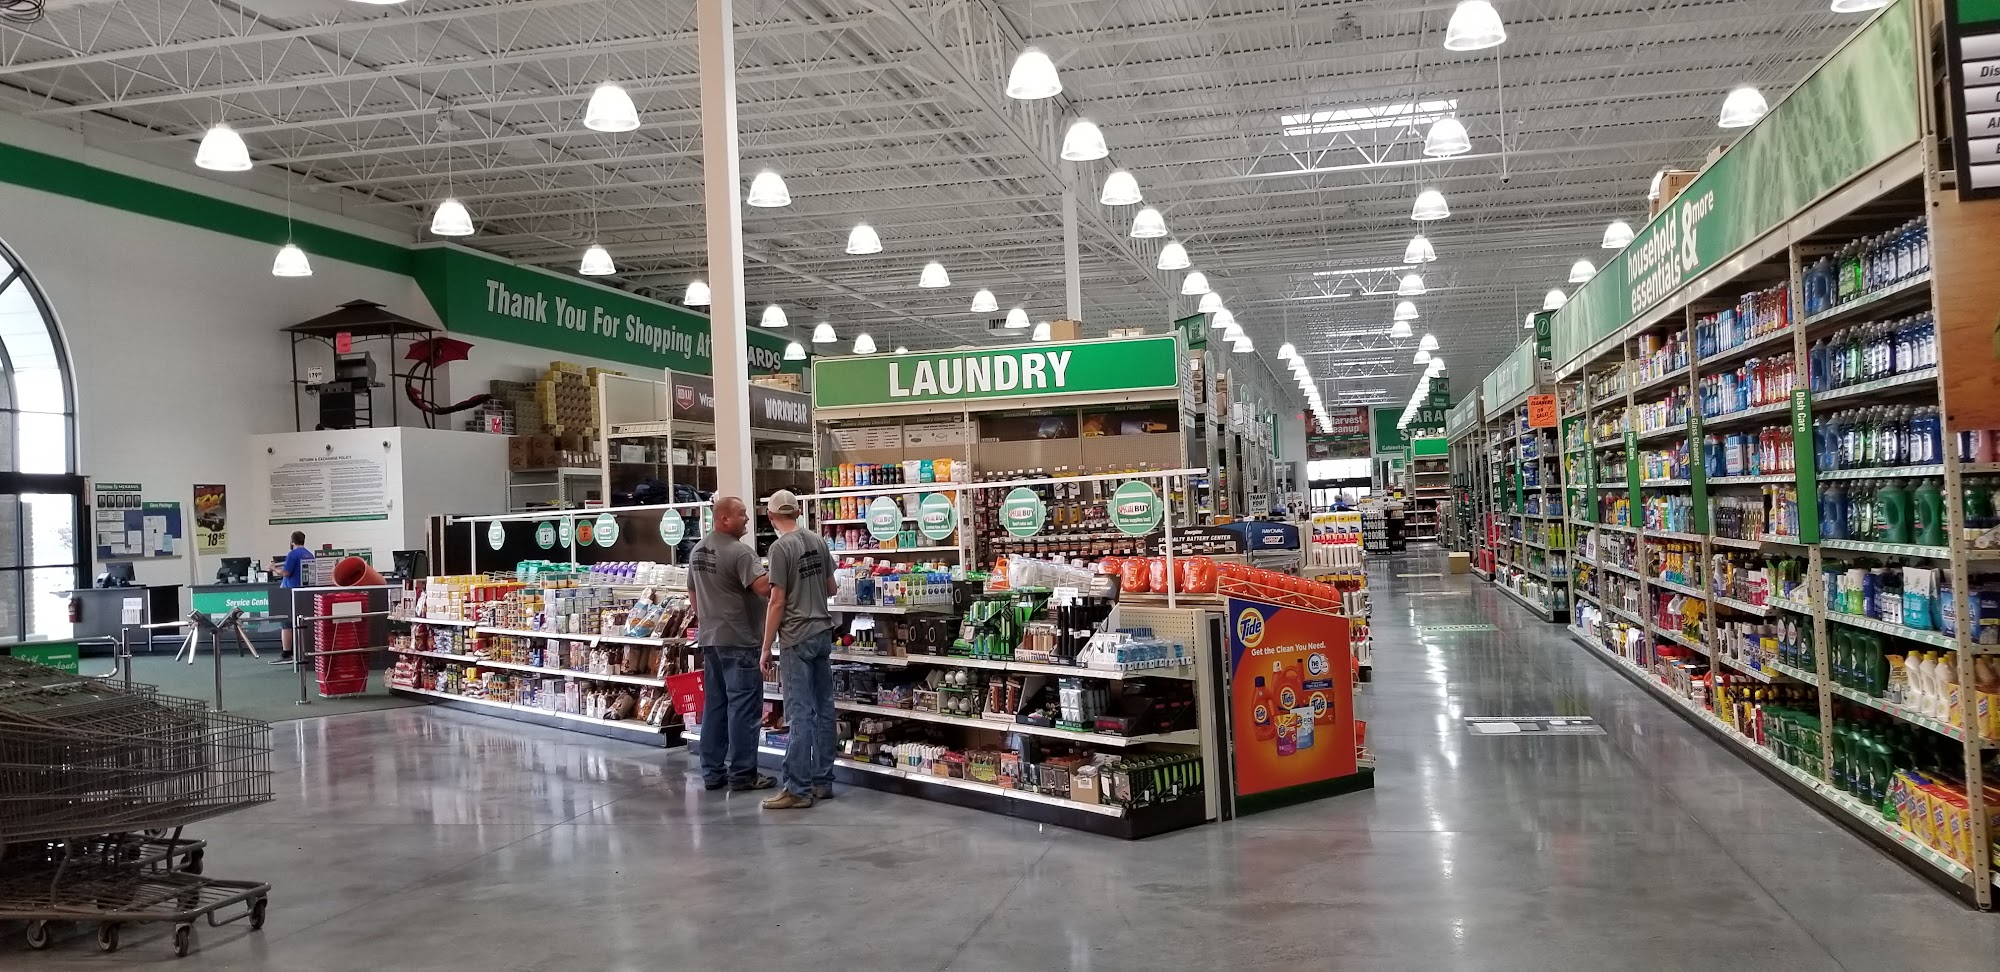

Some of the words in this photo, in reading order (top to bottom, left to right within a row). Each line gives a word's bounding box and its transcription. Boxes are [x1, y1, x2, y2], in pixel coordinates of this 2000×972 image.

[1692, 190, 1714, 225] more
[1628, 207, 1677, 286] household
[1682, 202, 1699, 271] &
[1631, 250, 1681, 315] essentials
[486, 278, 548, 324] Thank
[555, 296, 587, 335] You
[593, 306, 621, 339] For
[625, 314, 693, 360] Shopping
[696, 332, 712, 359] At
[747, 344, 782, 371] ARDS
[889, 350, 1072, 397] LAUNDRY
[699, 393, 714, 408] Wra
[764, 398, 808, 424] WORKWEAR
[1795, 391, 1805, 409] Dish
[1413, 410, 1446, 423] ARA
[1796, 411, 1806, 433] Care
[1333, 425, 1360, 434] eanup
[1692, 437, 1700, 466] Cleaners
[1135, 504, 1150, 512] BUY
[207, 532, 218, 546] 18
[225, 598, 250, 607] Service
[251, 598, 268, 606] Cente
[1240, 617, 1262, 641] Tide
[1251, 648, 1263, 656] Get
[1264, 646, 1275, 654] the
[1276, 645, 1294, 653] Clean
[1295, 643, 1307, 651] You
